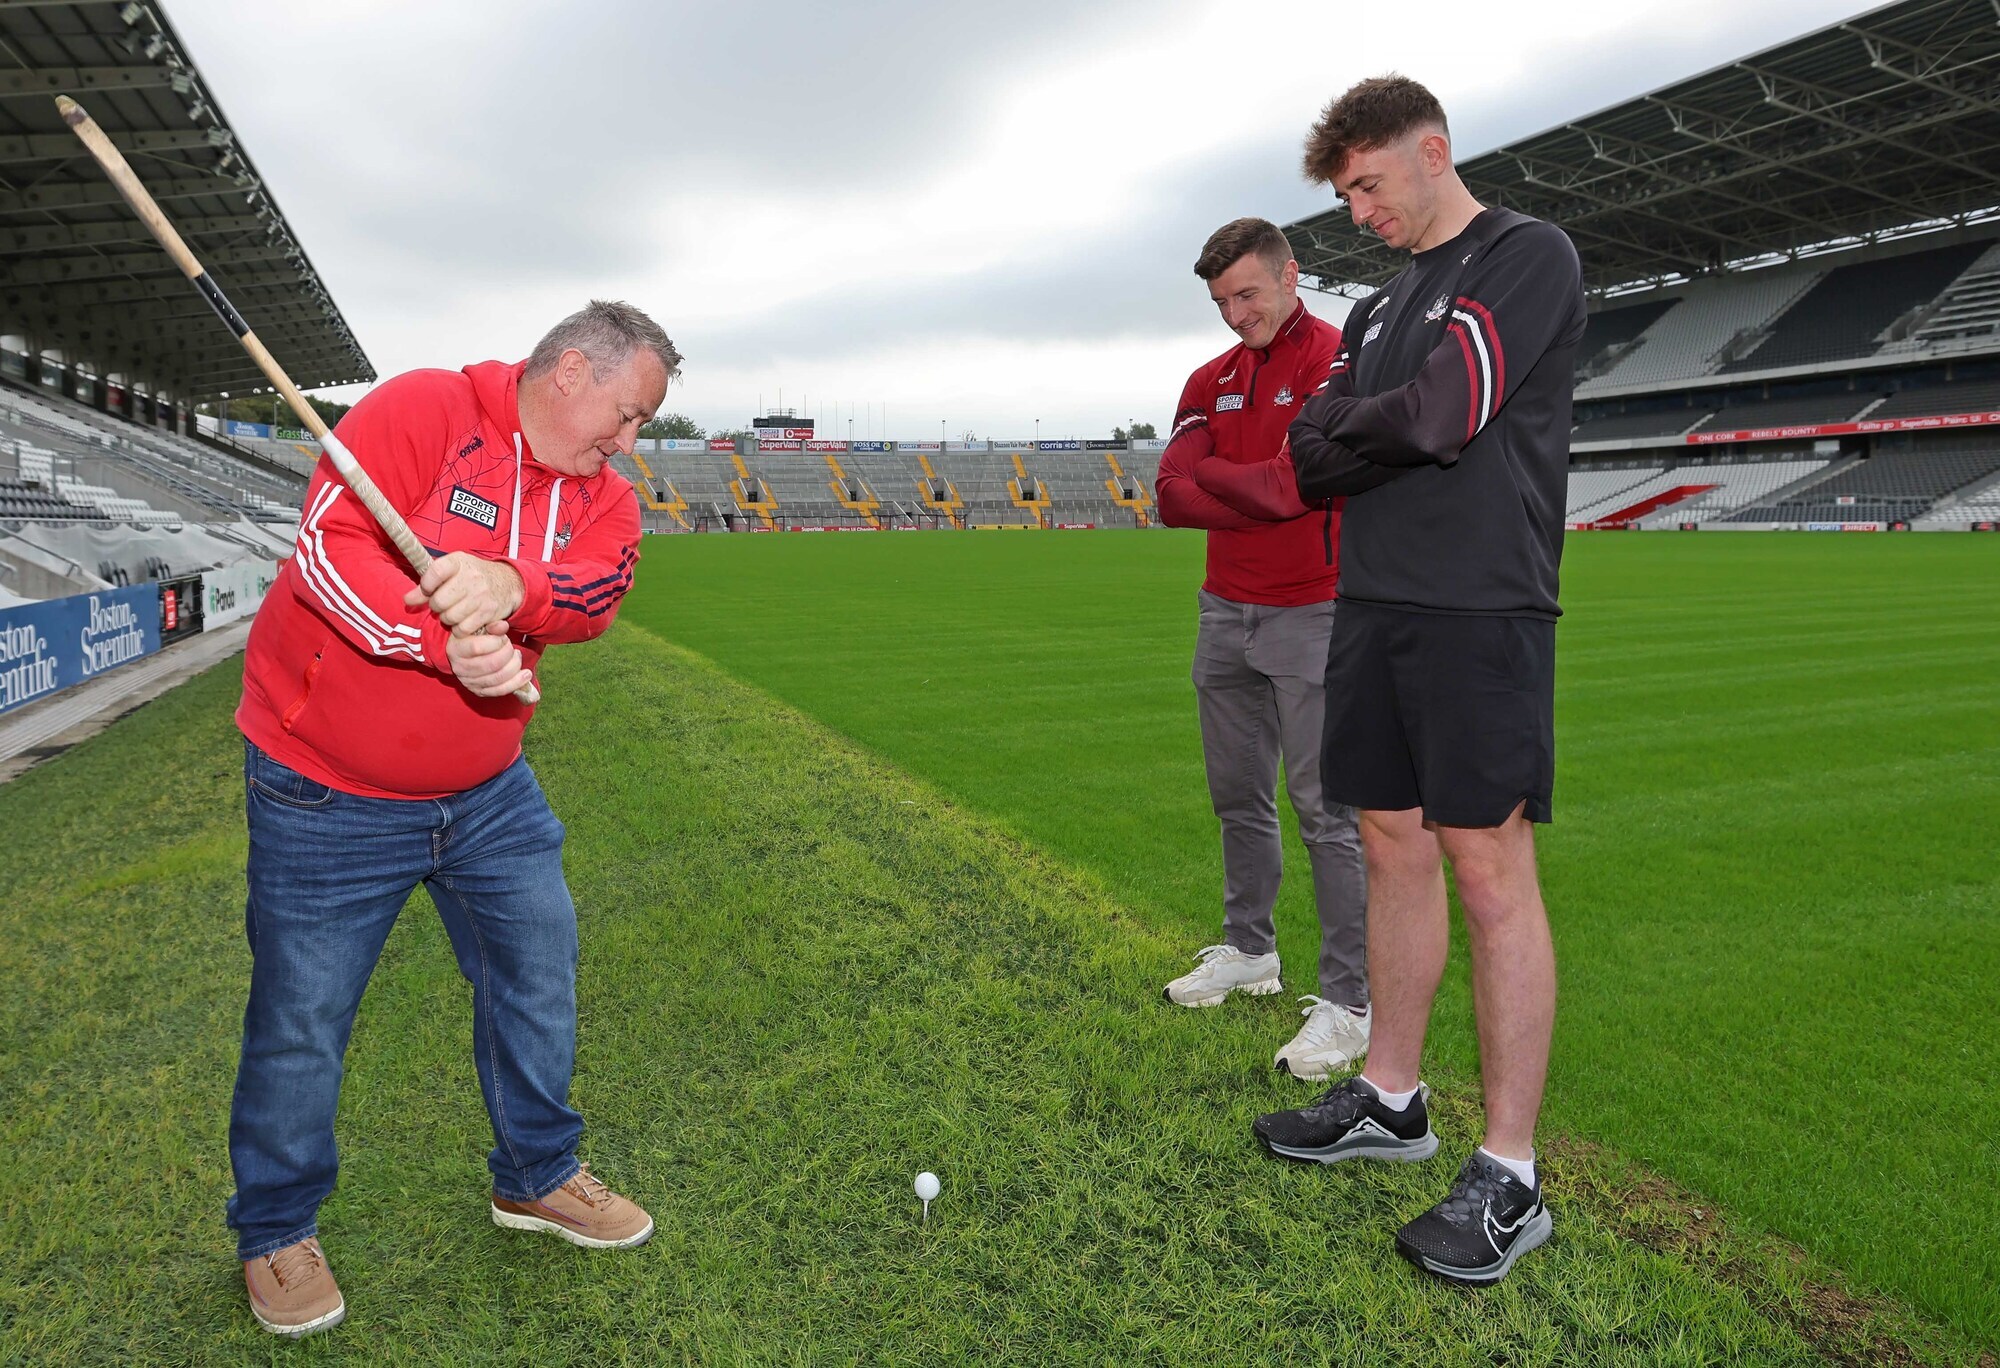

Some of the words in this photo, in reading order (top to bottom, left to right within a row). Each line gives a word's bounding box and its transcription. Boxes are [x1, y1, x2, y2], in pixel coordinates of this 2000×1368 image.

[1716, 433, 1736, 441] CORK
[1782, 427, 1817, 436] BOUNTY
[759, 440, 800, 450] SuperValu
[806, 440, 847, 450] SuperValu
[454, 503, 492, 524] DIRECT
[456, 492, 495, 514] SPORTS
[216, 586, 235, 613] Panda
[89, 595, 131, 636] Boston
[81, 613, 145, 675] Scientific
